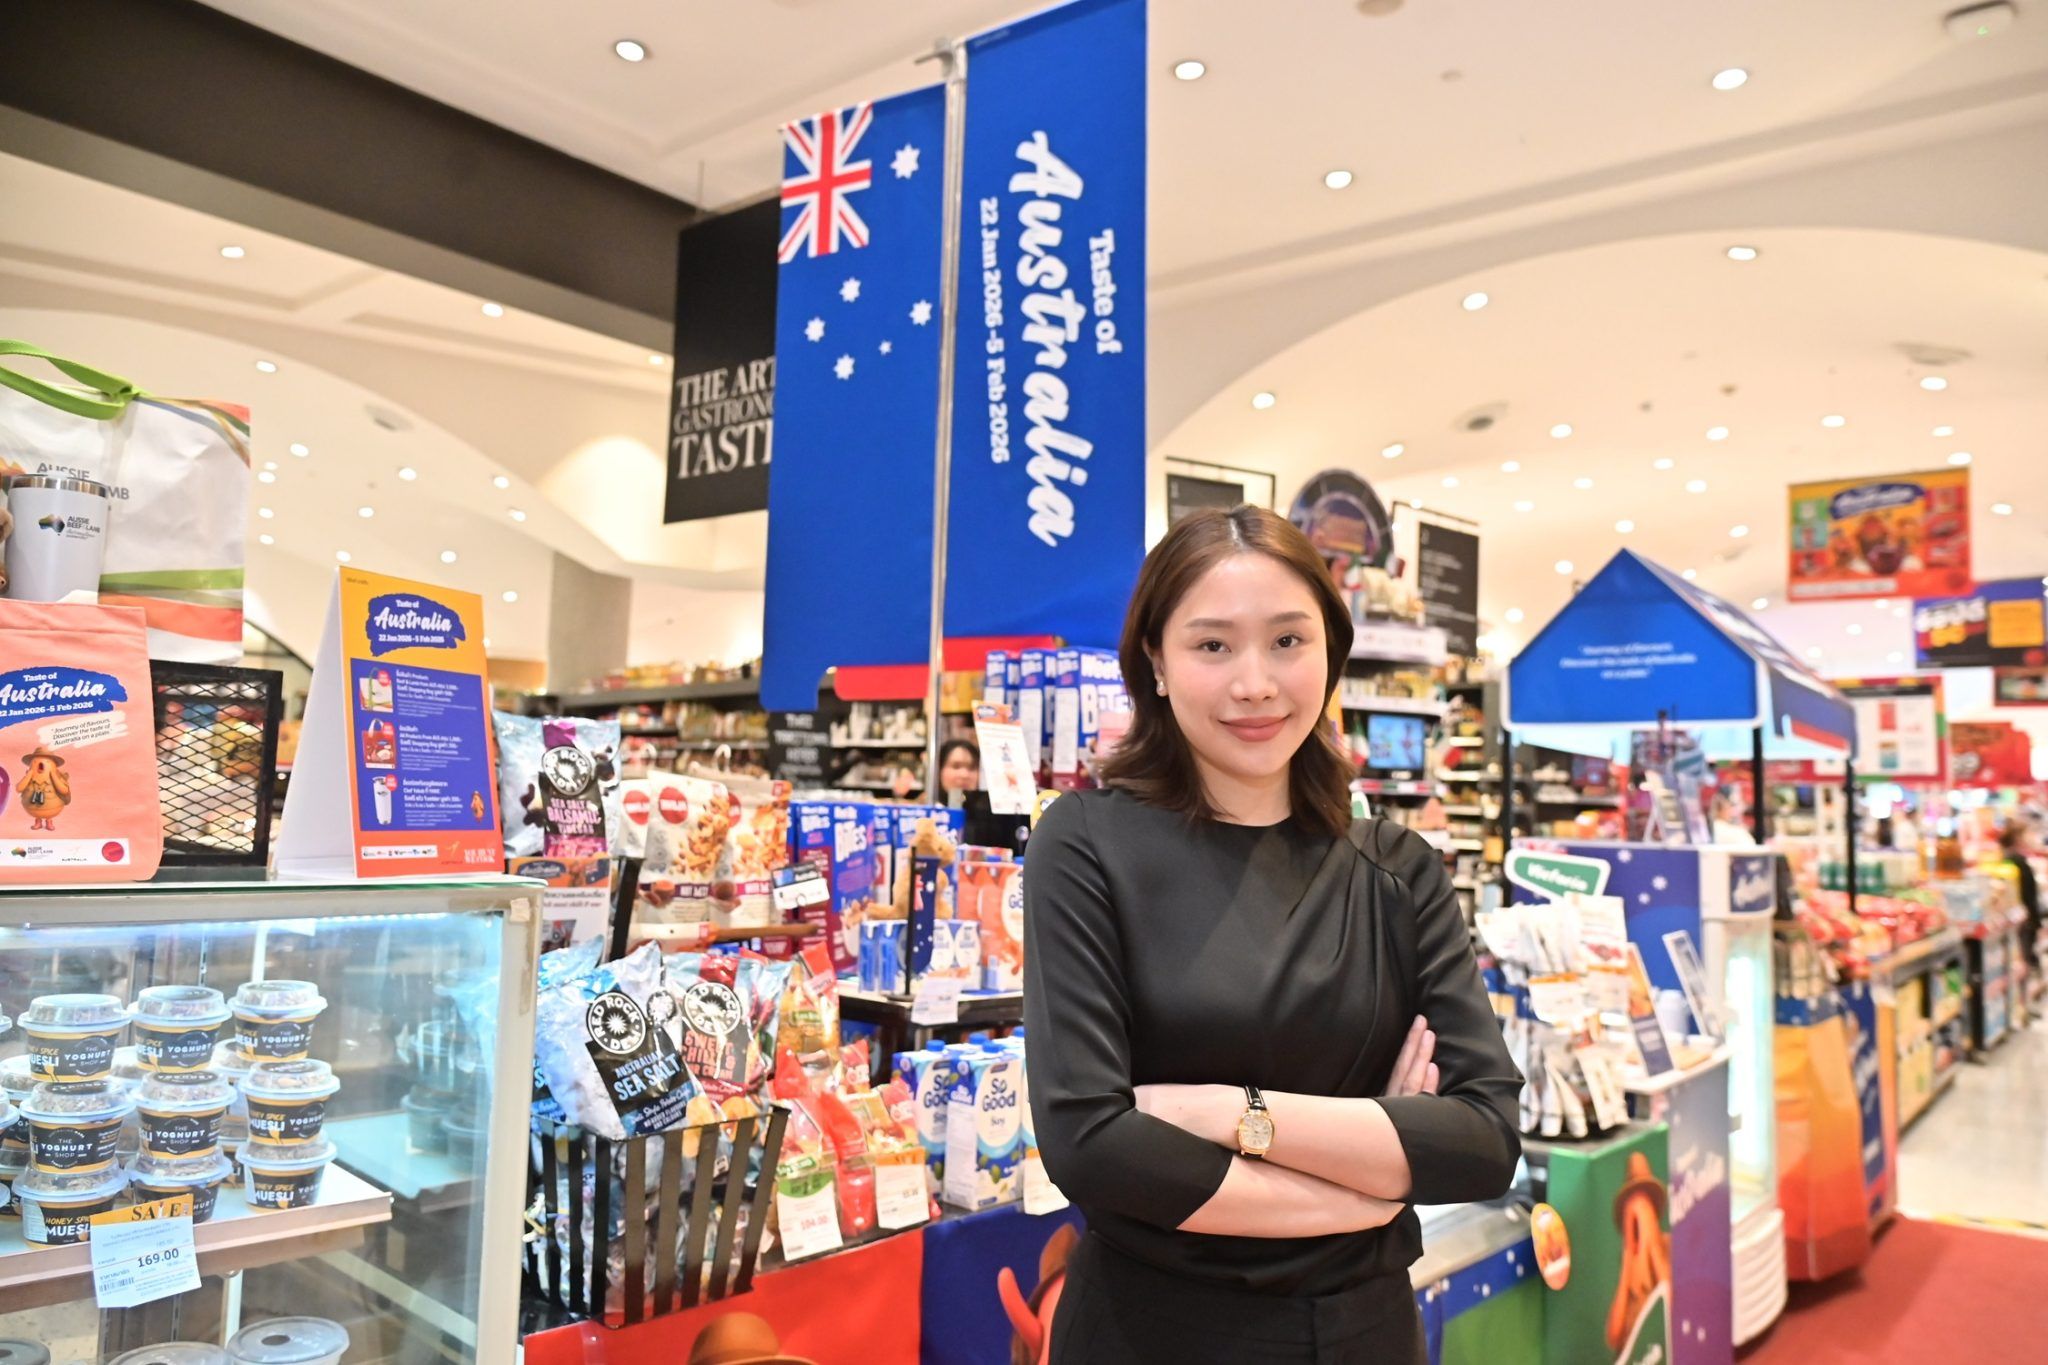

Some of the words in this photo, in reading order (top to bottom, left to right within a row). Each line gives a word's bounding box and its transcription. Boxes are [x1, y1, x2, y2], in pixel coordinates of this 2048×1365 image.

[980, 197, 998, 226] 22
[981, 228, 999, 268] Jan
[1090, 229, 1116, 317] Taste
[983, 269, 1003, 328] 2026
[1008, 130, 1093, 547] Australia
[1095, 320, 1122, 354] of
[676, 368, 728, 408] THE
[987, 357, 1006, 401] Feb
[989, 402, 1010, 463] 2026
[396, 599, 411, 608] Taste
[411, 600, 419, 608] of
[374, 606, 453, 632] Australia
[23, 673, 47, 682] Taste
[48, 672, 58, 680] of
[0, 679, 107, 706] Australia
[24, 706, 45, 715] 2026
[56, 703, 72, 712] Feb
[73, 701, 94, 709] 2026
[53, 730, 78, 740] Discover
[54, 736, 81, 745] Australia
[550, 798, 565, 809] SEA
[546, 806, 601, 824] BALSAMIC
[591, 1005, 605, 1038] RED
[605, 996, 640, 1024] ROCK
[167, 1042, 212, 1054] YOGHURT
[262, 1034, 305, 1044] YOGHURT
[31, 1053, 59, 1067] UESLI
[40, 1048, 60, 1056] SPICE
[64, 1050, 111, 1060] YOGHURT
[614, 1073, 647, 1101] SEA
[643, 1053, 681, 1086] SALT
[991, 1078, 1008, 1095] So
[924, 1091, 949, 1109] Goo
[982, 1090, 1016, 1112] Good
[266, 1112, 286, 1121] SPICE
[155, 1129, 205, 1139] YOGHURT
[41, 1143, 93, 1152] YOGHURT
[45, 1216, 73, 1225] HONEY
[131, 1202, 181, 1221] SALE
[47, 1223, 91, 1236] MUESL
[137, 1247, 179, 1268] 169.00
